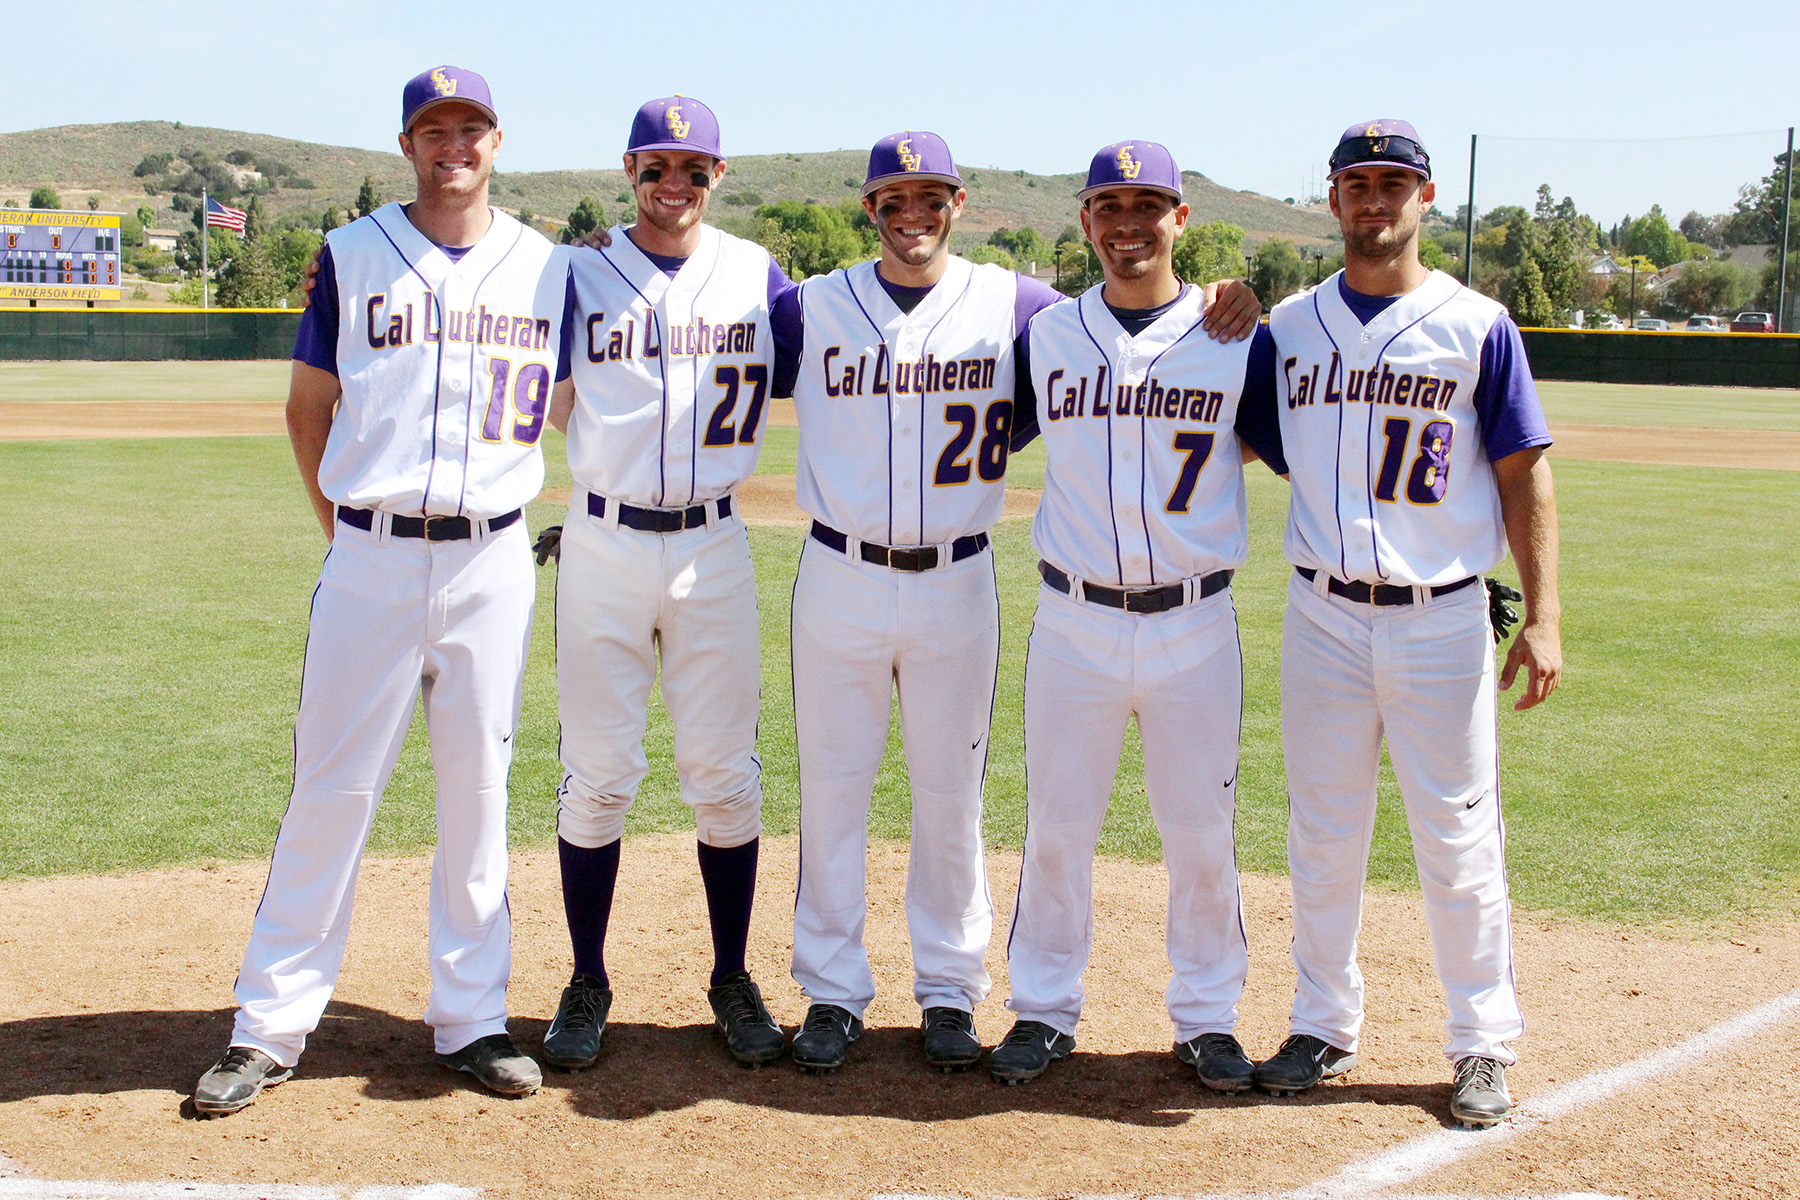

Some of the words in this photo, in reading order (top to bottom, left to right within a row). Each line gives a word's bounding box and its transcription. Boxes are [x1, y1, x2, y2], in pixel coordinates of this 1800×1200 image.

[0, 212, 33, 223] ERAN
[37, 214, 104, 226] UNIVERSITY
[0, 225, 26, 234] STRIKE
[49, 227, 63, 235] OUT
[10, 288, 68, 298] ANDERSON
[71, 289, 101, 299] FIELD
[367, 293, 413, 350] Cal
[423, 290, 551, 352] Lutheran
[587, 312, 634, 364] Cal
[642, 307, 756, 359] Lutheran
[824, 345, 866, 398] Cal
[872, 343, 996, 395] Lutheran
[1047, 368, 1087, 422] Cal
[1092, 365, 1224, 424] Lutheran
[1284, 356, 1320, 411] Cal
[1324, 350, 1457, 412] Lutheran
[480, 355, 551, 447] 19
[701, 363, 768, 448] 27
[932, 398, 1015, 488] 28
[1164, 430, 1216, 514] 7
[1374, 415, 1456, 506] 18
